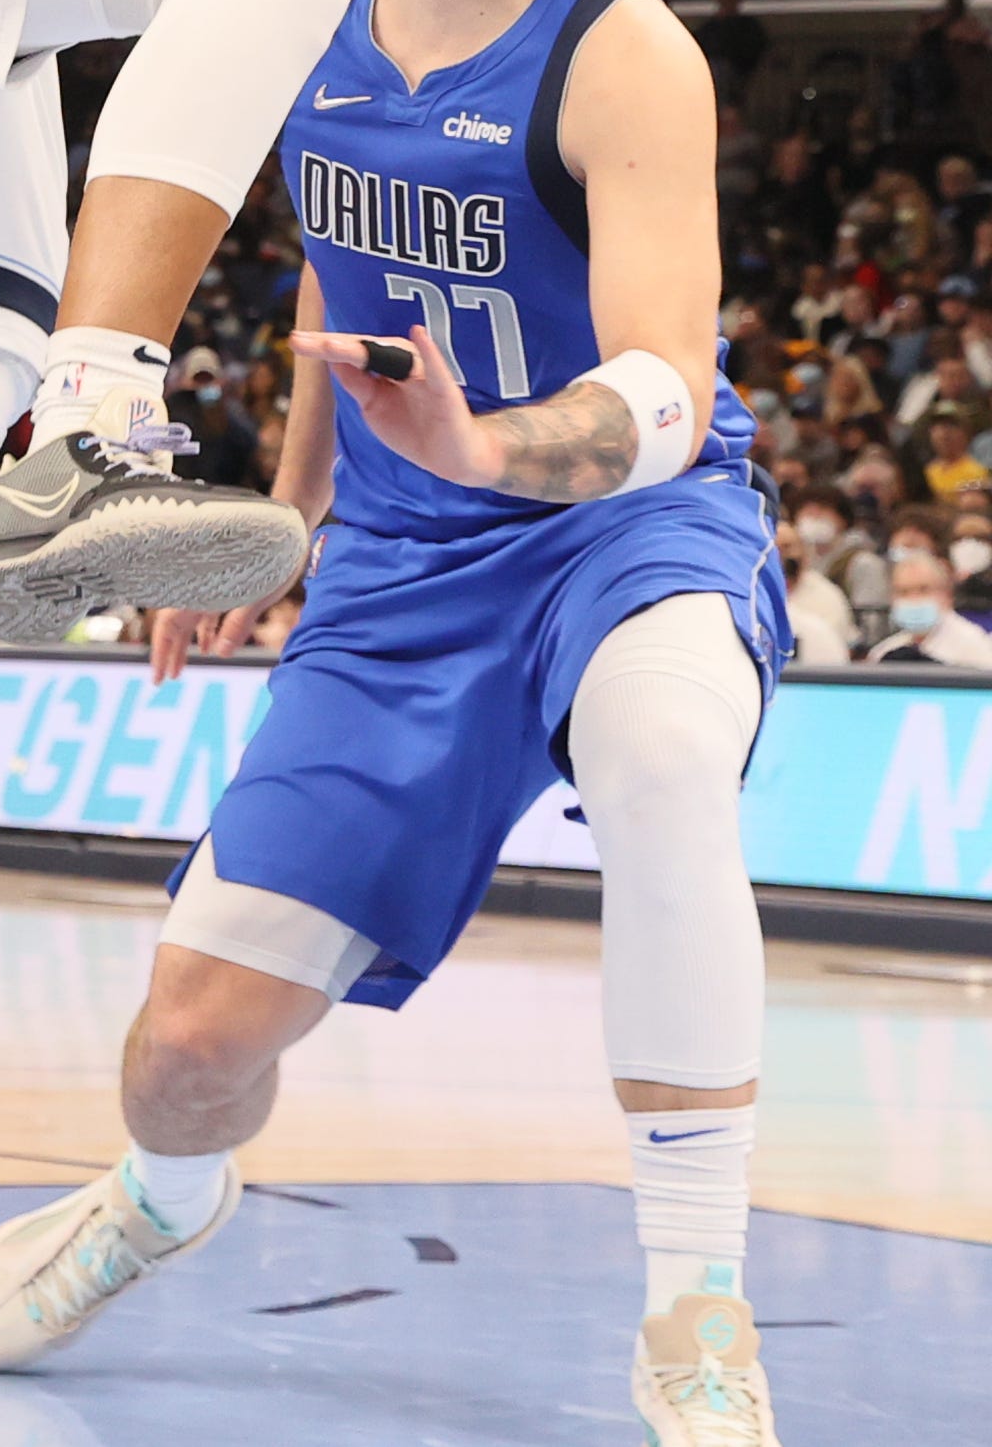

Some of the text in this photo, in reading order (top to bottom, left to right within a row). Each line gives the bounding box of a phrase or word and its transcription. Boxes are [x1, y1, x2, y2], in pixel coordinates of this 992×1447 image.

[442, 111, 513, 145] chime
[300, 150, 507, 278] DALLAS
[384, 272, 531, 400] 77
[854, 702, 992, 892] N
